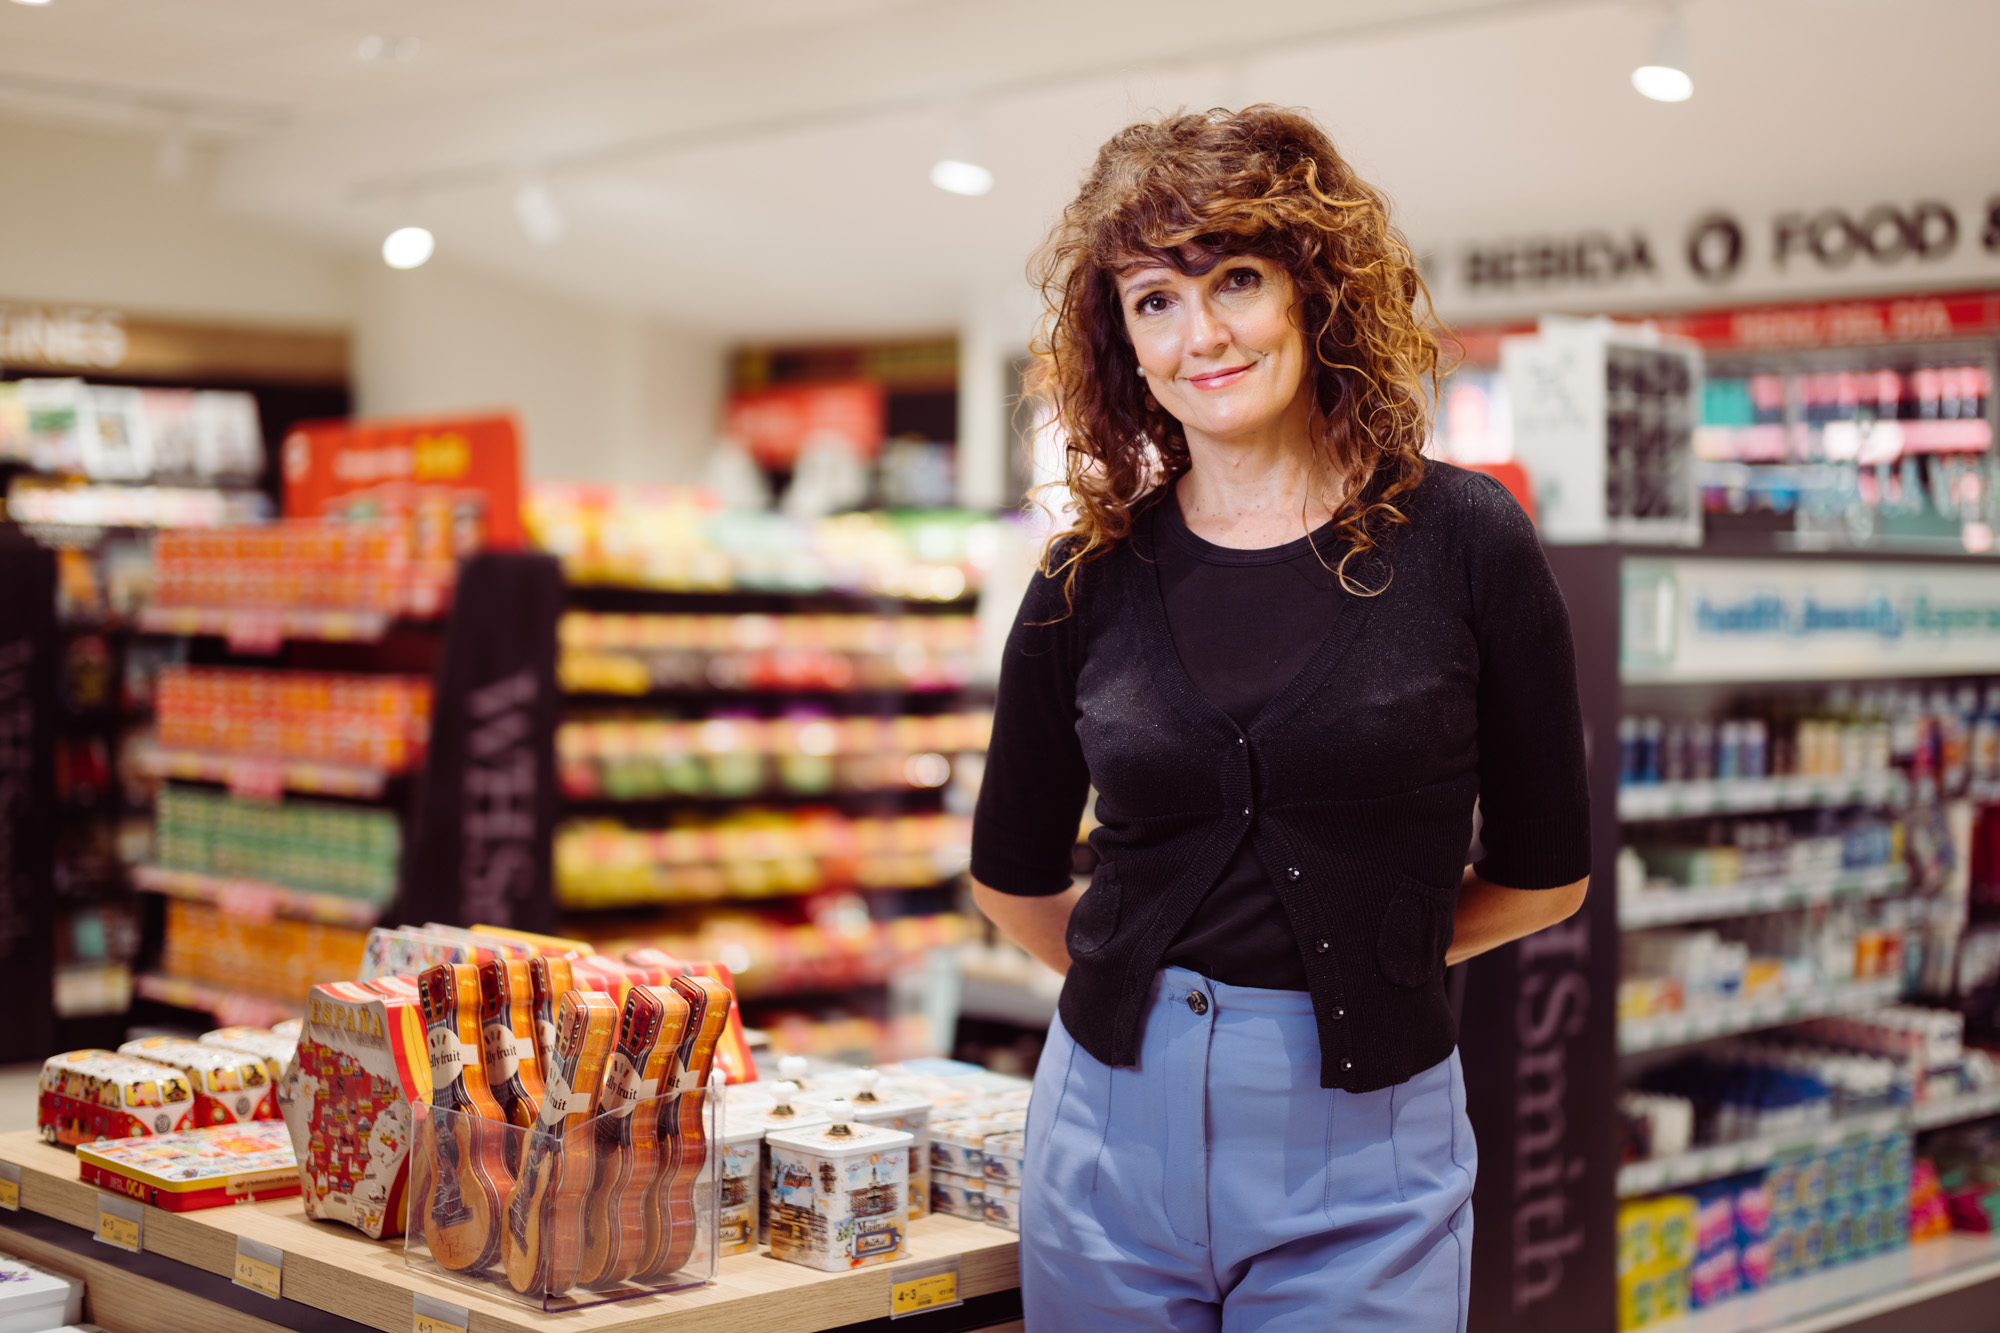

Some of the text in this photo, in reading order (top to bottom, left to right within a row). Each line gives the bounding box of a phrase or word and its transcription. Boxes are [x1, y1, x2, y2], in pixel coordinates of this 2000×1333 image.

[1772, 198, 1959, 272] FOOD
[310, 1000, 383, 1038] ESPAÑA
[441, 1050, 460, 1064] fruit
[496, 1045, 517, 1061] fruit
[616, 1081, 637, 1100] fruit
[126, 1179, 145, 1200] OCA
